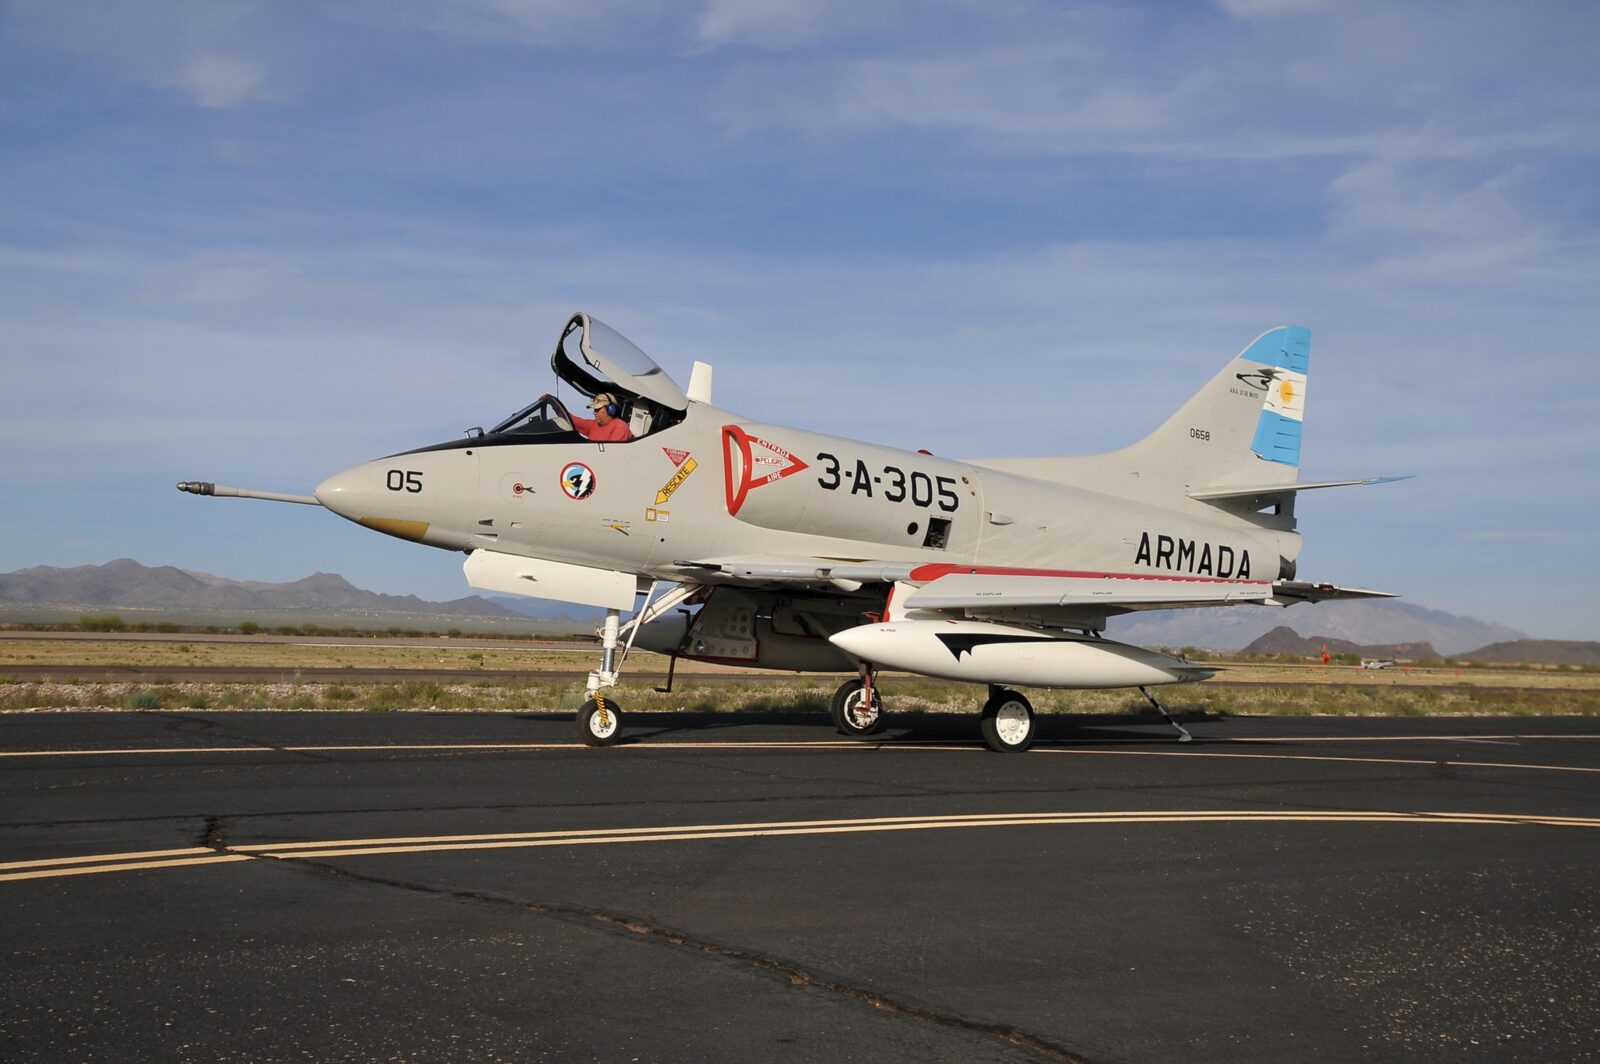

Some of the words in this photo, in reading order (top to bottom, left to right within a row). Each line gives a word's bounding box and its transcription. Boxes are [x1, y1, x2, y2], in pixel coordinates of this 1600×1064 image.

[1189, 428, 1211, 441] 0658
[757, 438, 790, 459] ENTRADA
[760, 457, 784, 466] PELIGRO
[386, 469, 423, 493] 05
[662, 467, 689, 497] RESCATE
[767, 471, 783, 483] AIRE
[816, 452, 959, 512] 3-A-305
[1134, 531, 1250, 580] ARMADA
